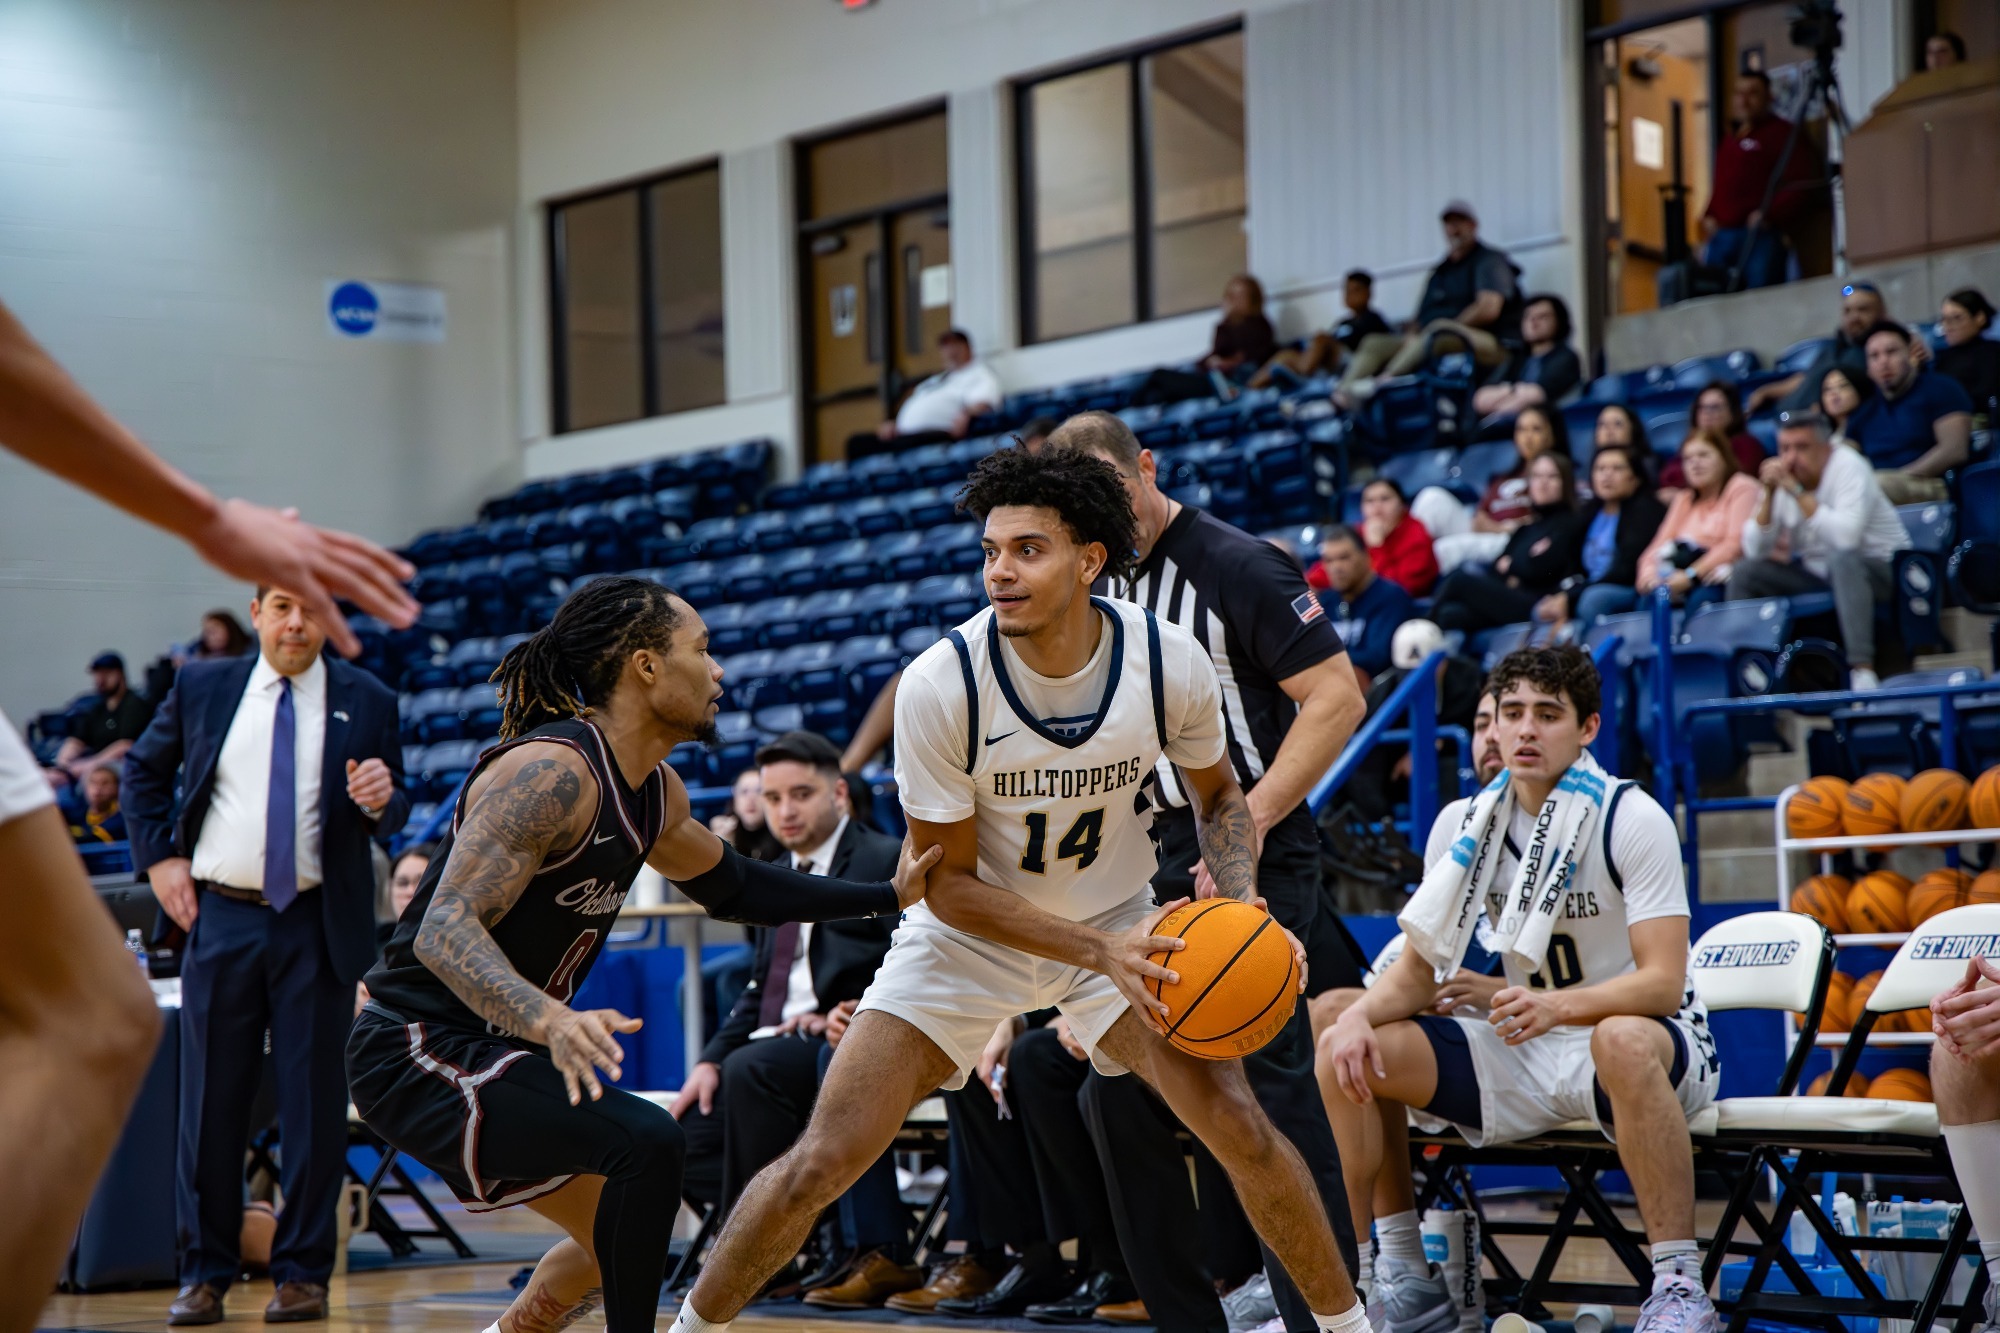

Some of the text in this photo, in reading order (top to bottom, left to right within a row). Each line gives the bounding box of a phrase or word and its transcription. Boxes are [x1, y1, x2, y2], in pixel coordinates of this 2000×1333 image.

[993, 756, 1141, 799] HILLTOPPERS
[1018, 805, 1108, 877] 14
[1518, 800, 1556, 912] POWERADE
[1539, 807, 1591, 916] ERADE
[543, 928, 598, 1006] 0
[1529, 932, 1585, 990] 0
[1463, 1211, 1477, 1308] POWERA
